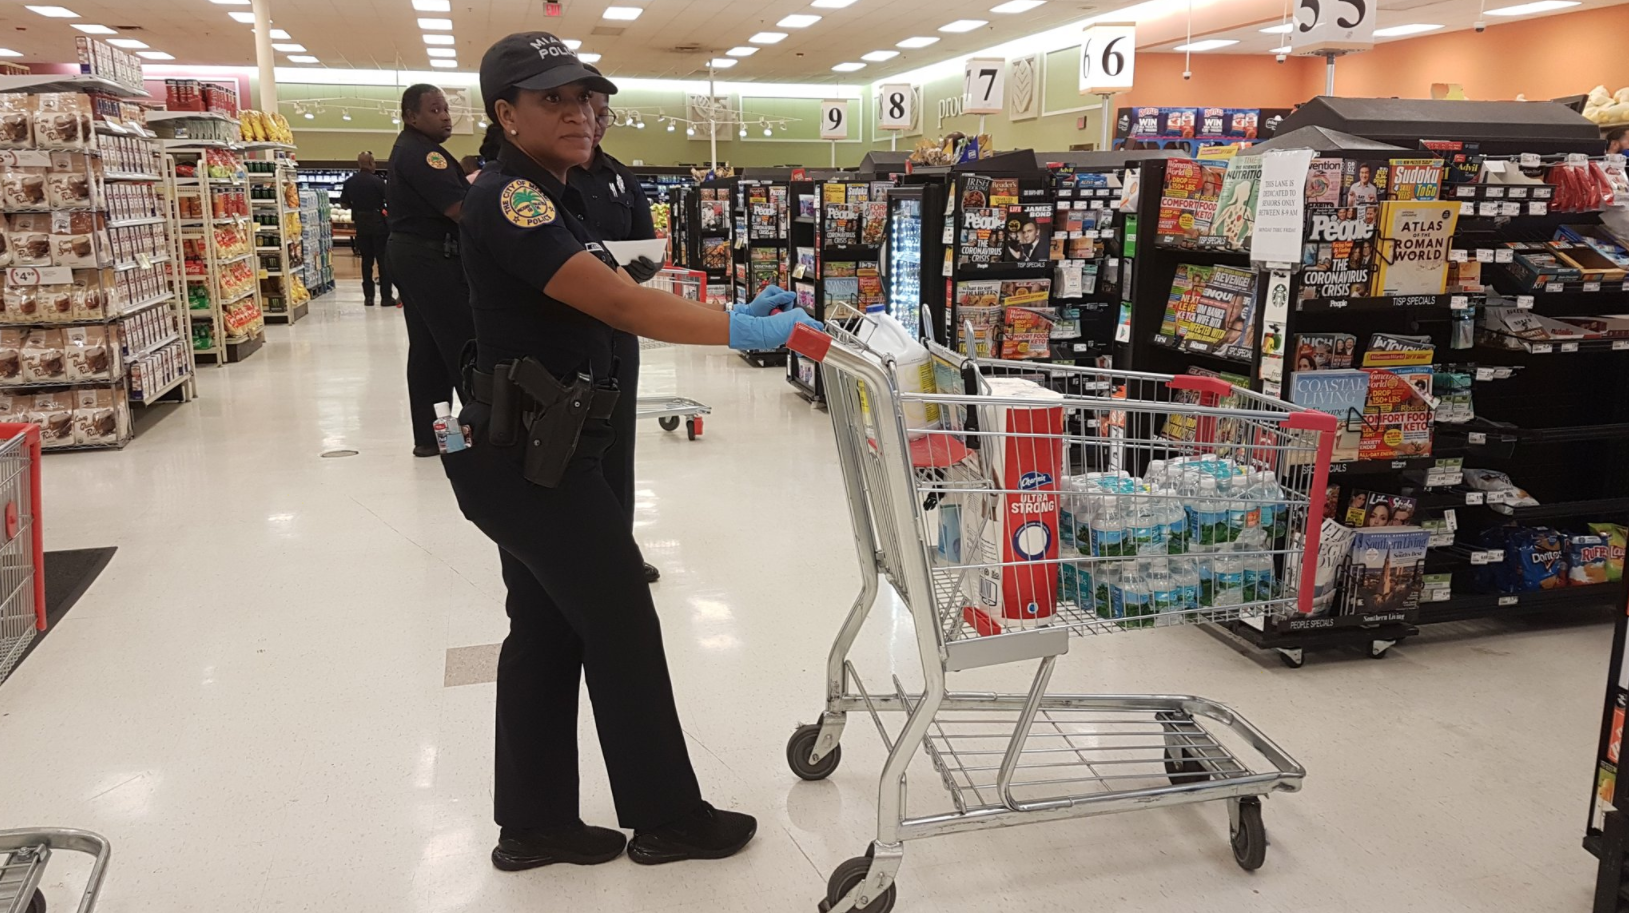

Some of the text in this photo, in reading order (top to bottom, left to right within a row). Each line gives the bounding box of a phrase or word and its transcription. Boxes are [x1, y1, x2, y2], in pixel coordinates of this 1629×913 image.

[530, 37, 564, 50] MIA
[1102, 36, 1126, 76] 6
[979, 69, 997, 101] 7
[889, 92, 905, 119] 8
[829, 108, 842, 130] 9
[1458, 162, 1478, 172] Advil
[1394, 166, 1440, 183] Sudoku
[503, 180, 526, 214] THE CITY OF
[1162, 199, 1217, 211] COMFORT FOOD
[1196, 210, 1212, 219] KETO
[1310, 215, 1374, 241] People
[1402, 221, 1443, 232] ATLAS
[1395, 238, 1443, 249] ROMAN
[962, 247, 1002, 255] CORONAVIRUS
[1395, 250, 1441, 261] WORLD
[1332, 259, 1349, 271] THE
[1215, 272, 1250, 287] REVENGE!
[1304, 270, 1368, 284] CORONAVIRUS
[1322, 283, 1350, 296] CRISIS
[1181, 295, 1200, 303] NEXT
[1330, 300, 1347, 308] People
[1393, 296, 1435, 305] TISP SPECIALS
[1298, 378, 1365, 393] COASTAL
[1303, 391, 1356, 405] LIVING
[1404, 422, 1428, 431] KETO
[1021, 494, 1048, 502] ULTRA
[1012, 501, 1054, 514] STRONG
[1364, 537, 1427, 550] Southern Living
[1532, 551, 1562, 564] Doritos
[1290, 619, 1334, 629] PEOPLE SPECIALS
